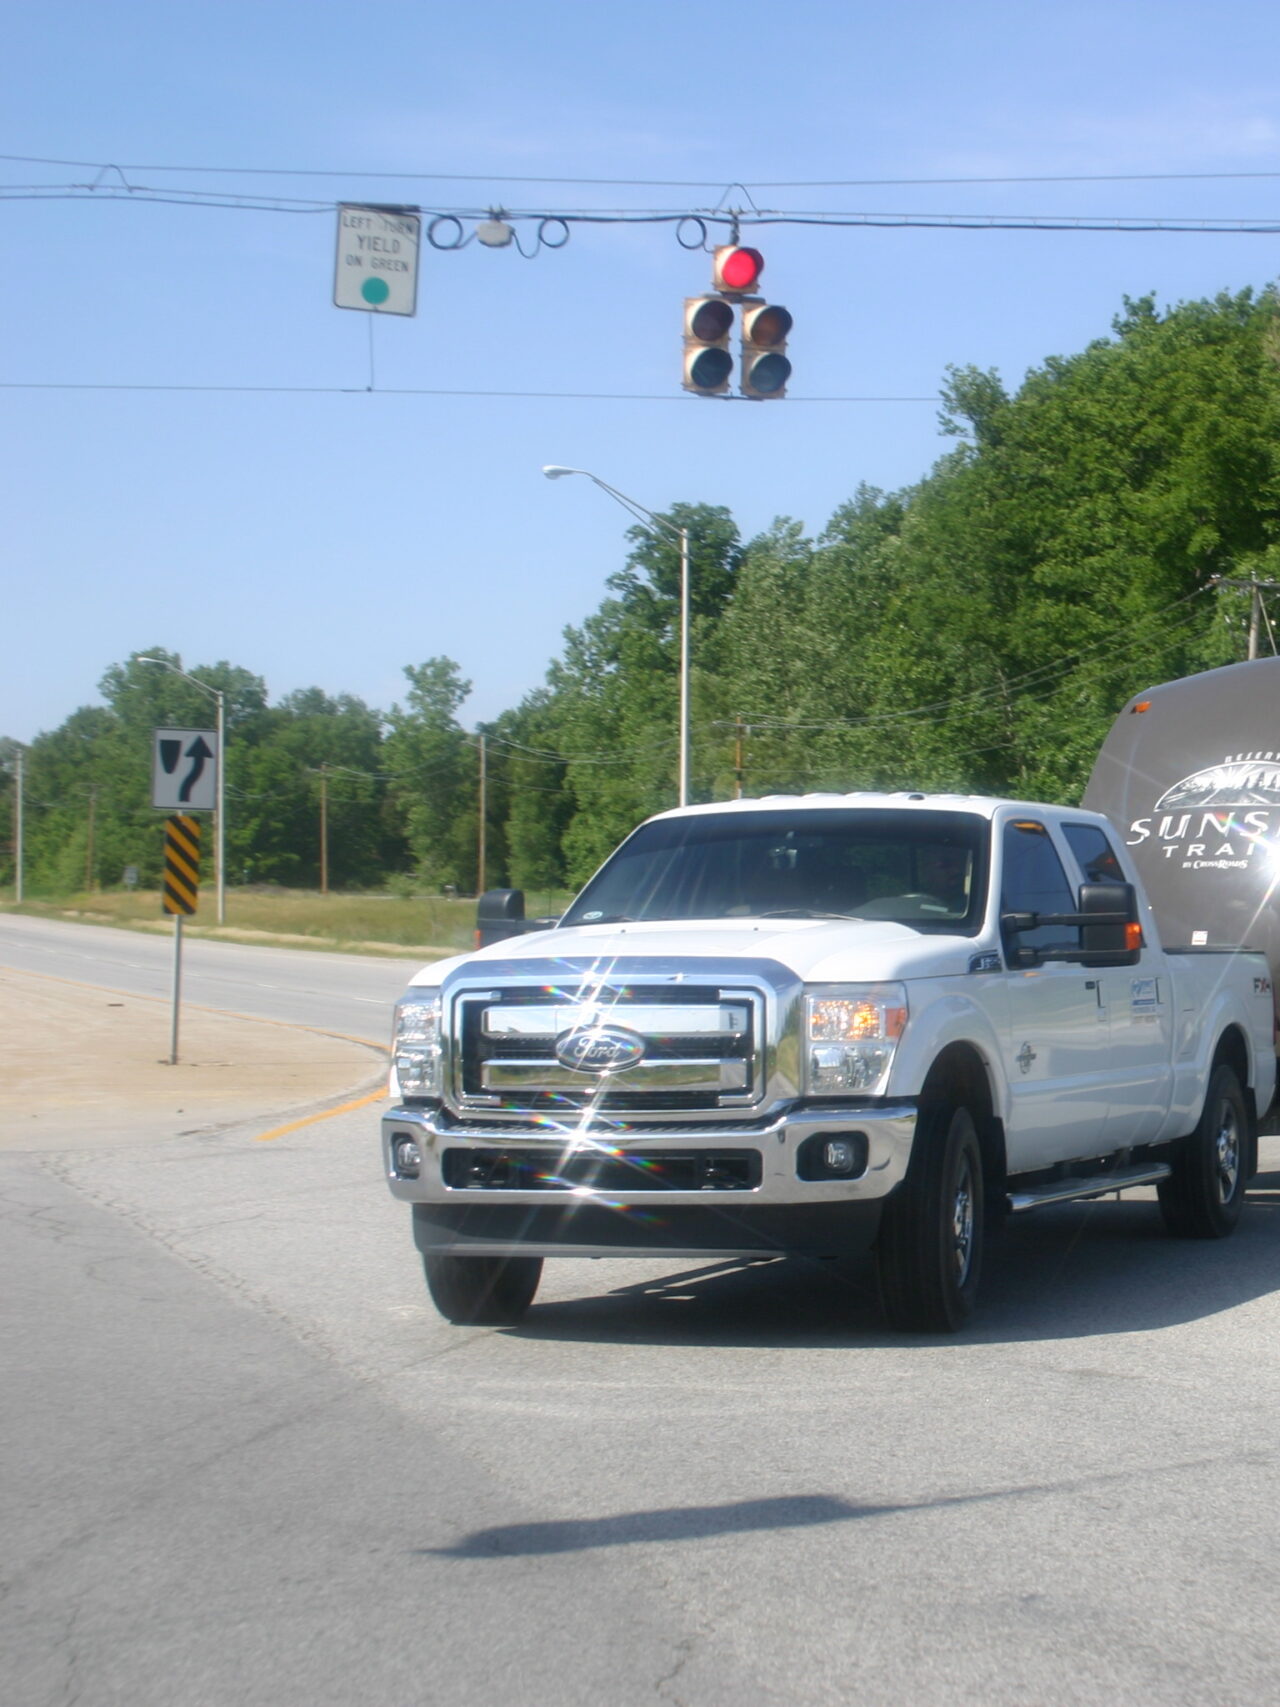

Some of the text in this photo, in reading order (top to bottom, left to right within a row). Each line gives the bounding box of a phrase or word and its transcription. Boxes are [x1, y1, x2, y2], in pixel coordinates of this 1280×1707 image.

[343, 216, 414, 234] LEFT TURN
[357, 235, 401, 254] YIELD
[346, 254, 409, 272] ON GREEN
